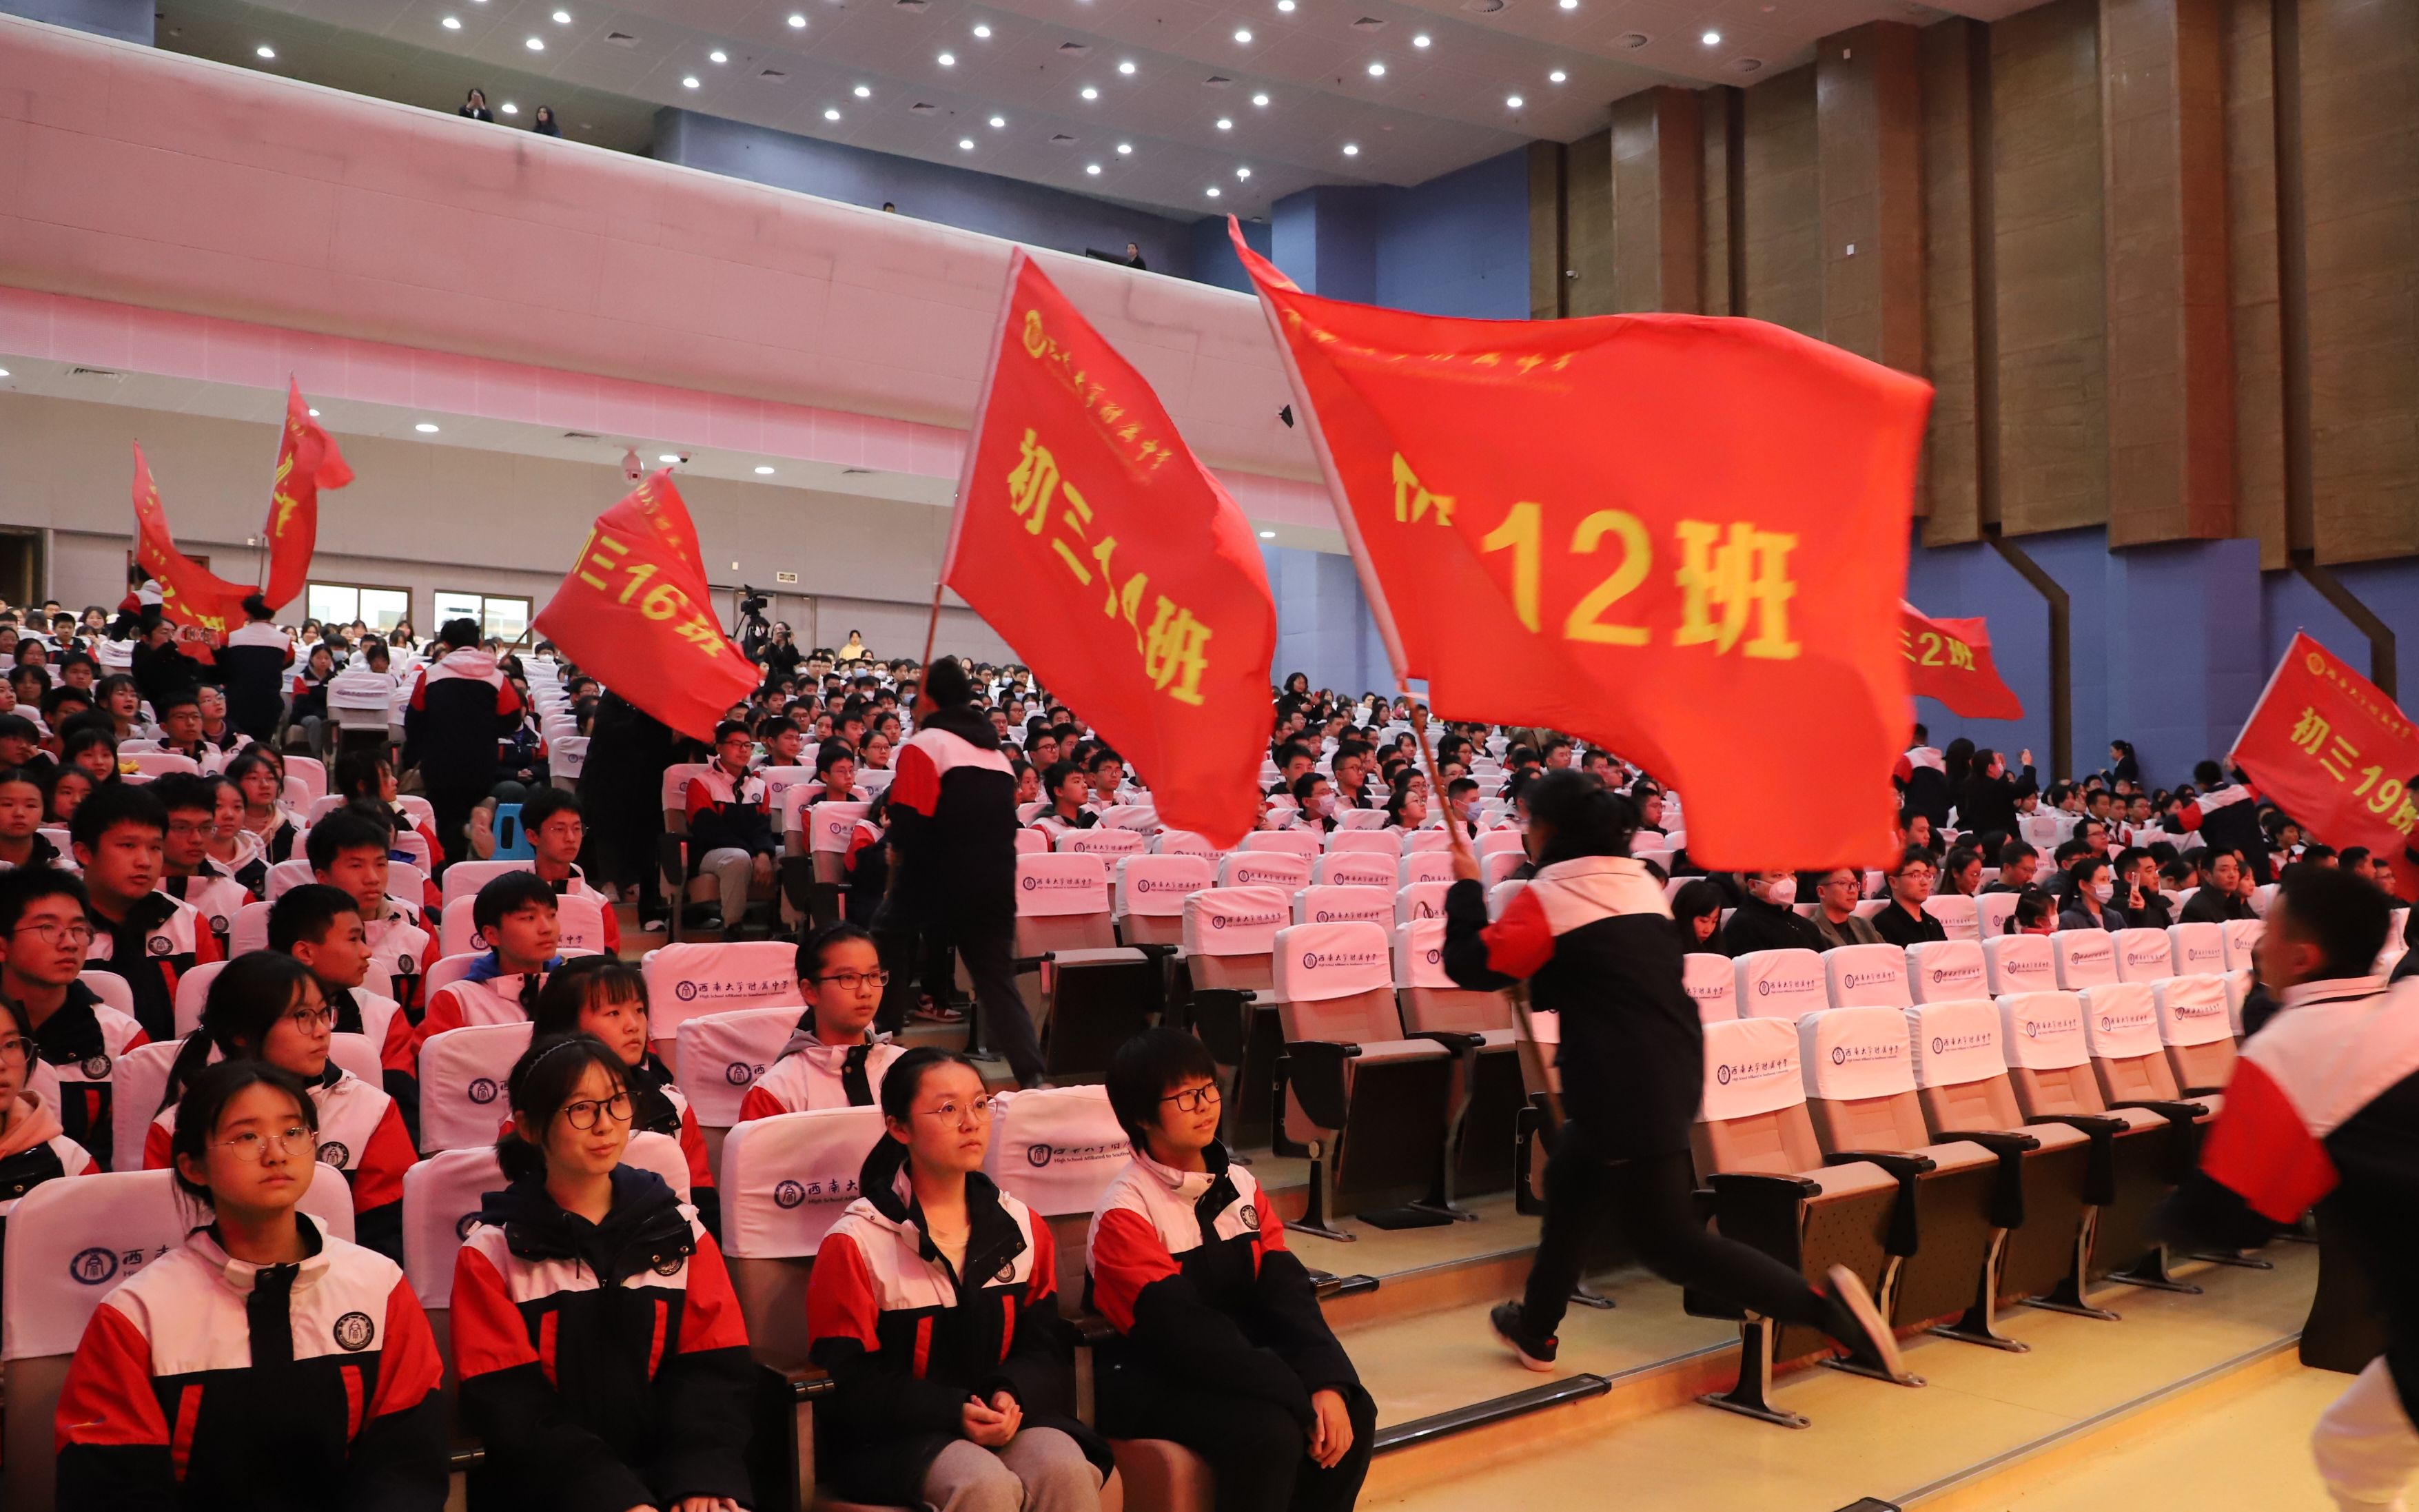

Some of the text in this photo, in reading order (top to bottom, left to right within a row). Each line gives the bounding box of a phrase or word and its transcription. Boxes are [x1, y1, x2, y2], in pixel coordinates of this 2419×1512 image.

[1392, 451, 1802, 660] 12班
[573, 526, 726, 657] 三16班
[1105, 863, 1110, 871] 5
[699, 980, 789, 992] 西南大学附属中学
